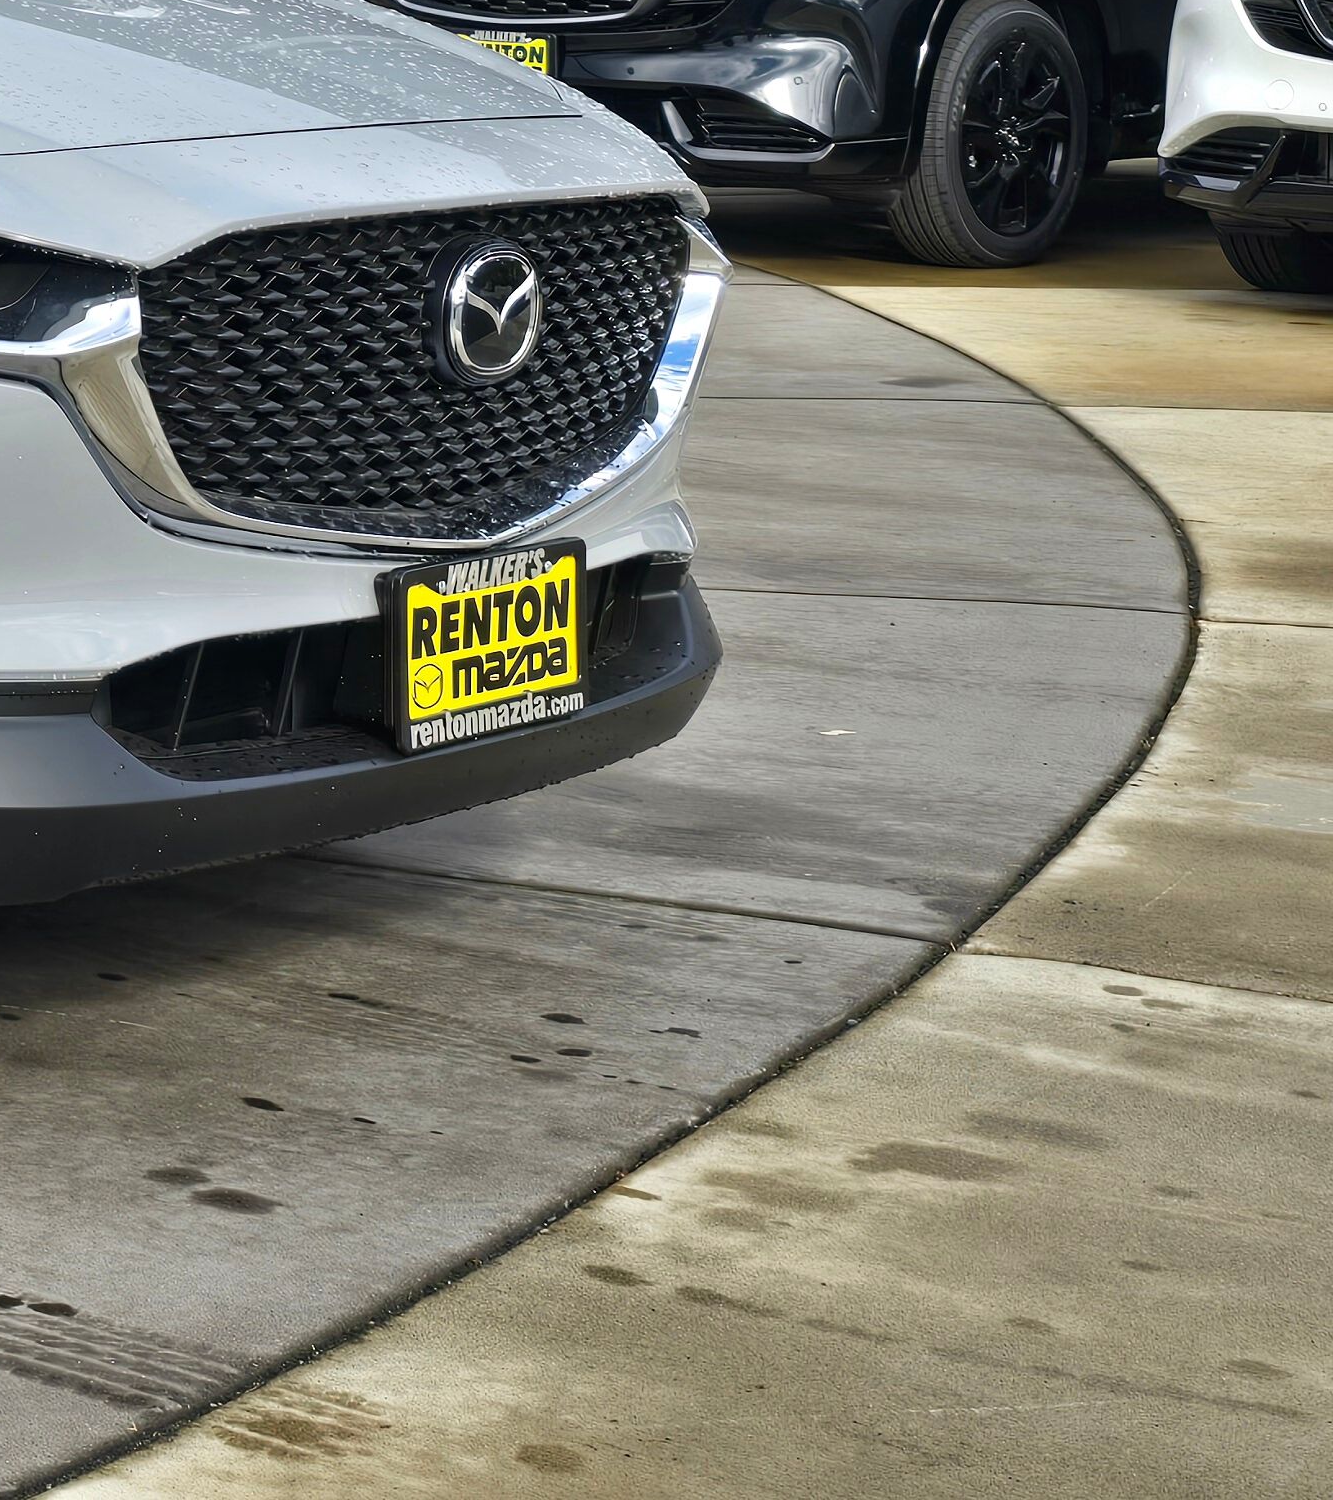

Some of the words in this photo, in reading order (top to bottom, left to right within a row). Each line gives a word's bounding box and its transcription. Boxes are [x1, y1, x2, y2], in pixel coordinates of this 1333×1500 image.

[446, 548, 546, 595] WALKER'S
[411, 578, 570, 660] RENTON
[452, 637, 568, 698] mazda
[410, 691, 584, 749] rentonmazda.com
